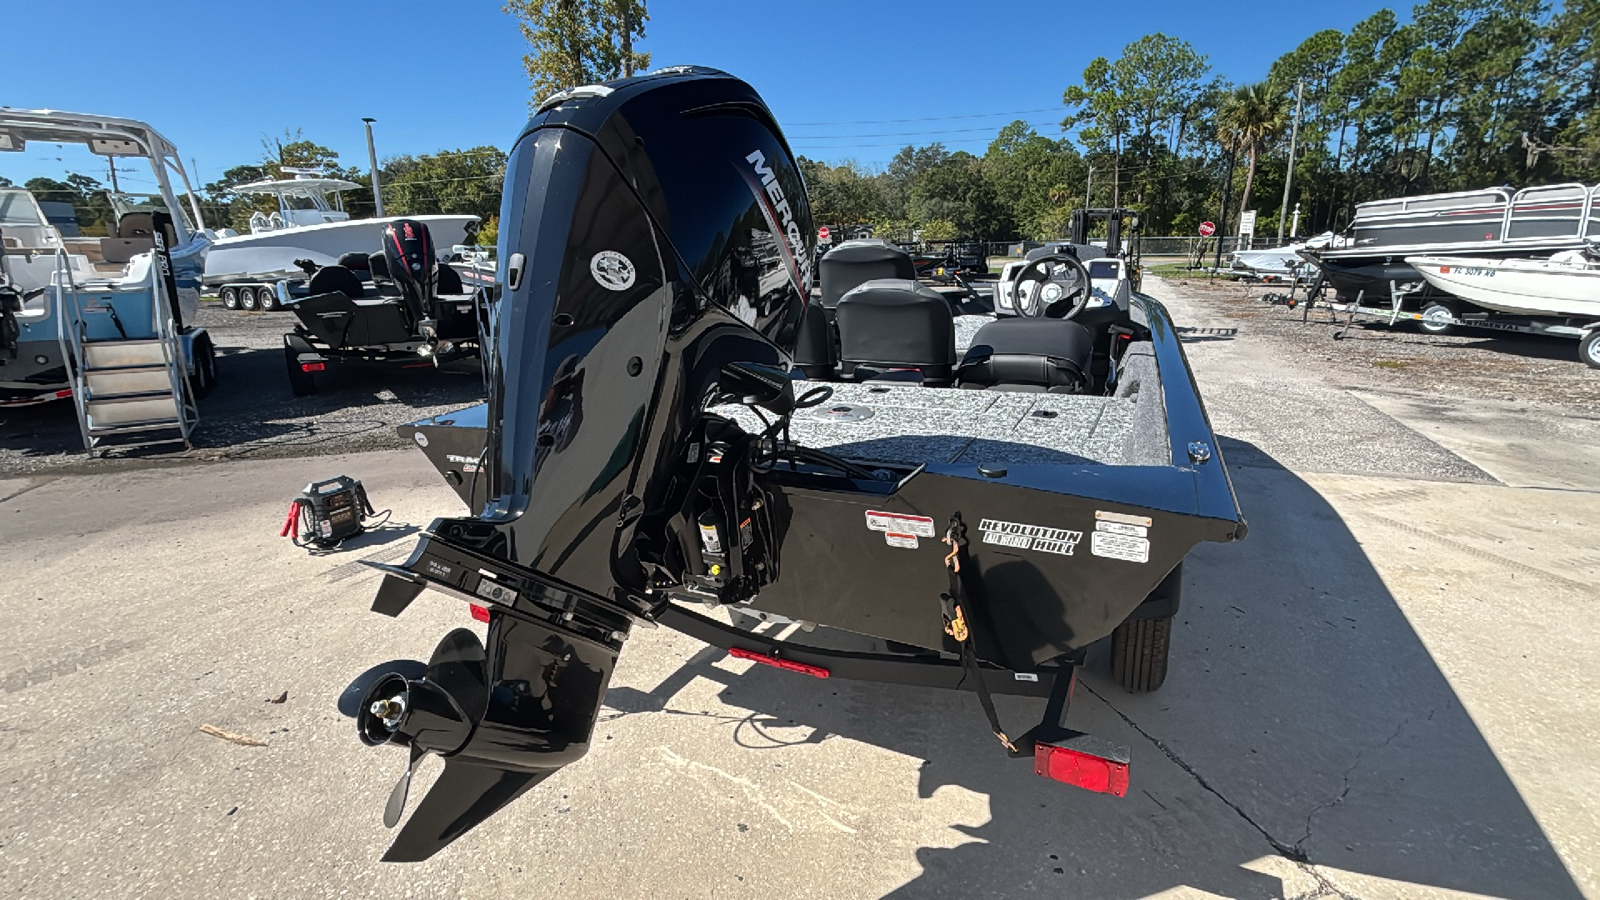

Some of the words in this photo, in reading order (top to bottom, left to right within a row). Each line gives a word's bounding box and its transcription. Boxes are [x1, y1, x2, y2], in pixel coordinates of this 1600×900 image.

[745, 149, 812, 294] MERCUR
[979, 518, 1083, 544] REVOLUTION
[1032, 539, 1075, 556] HULL
